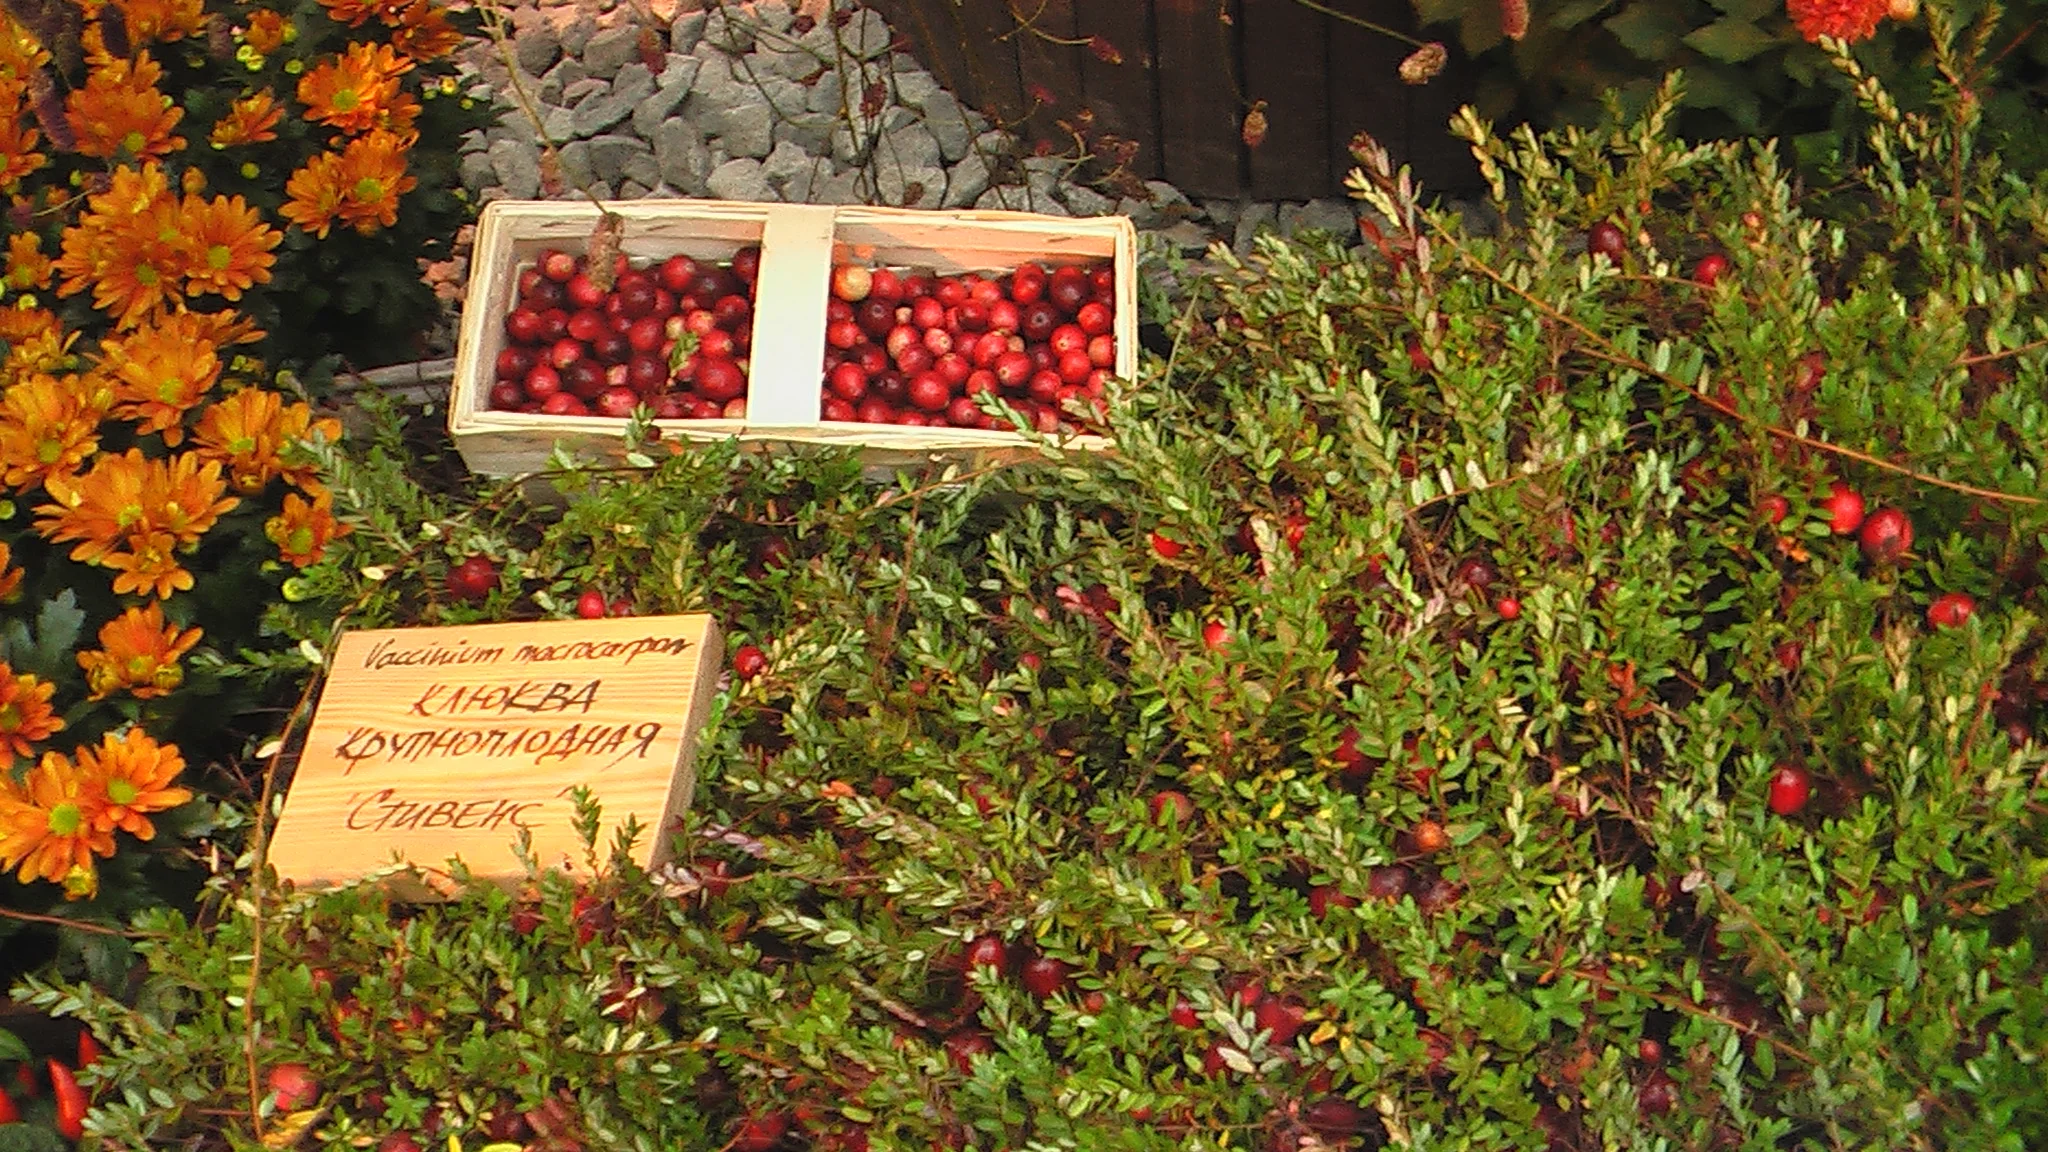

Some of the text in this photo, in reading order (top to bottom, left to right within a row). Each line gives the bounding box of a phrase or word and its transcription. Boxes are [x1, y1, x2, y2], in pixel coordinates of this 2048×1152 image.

[364, 636, 694, 670] Vaccinium macrocarpon
[408, 680, 601, 716] КЛЮКВА
[334, 722, 662, 776] КРУПНОПЛОДНАЯ
